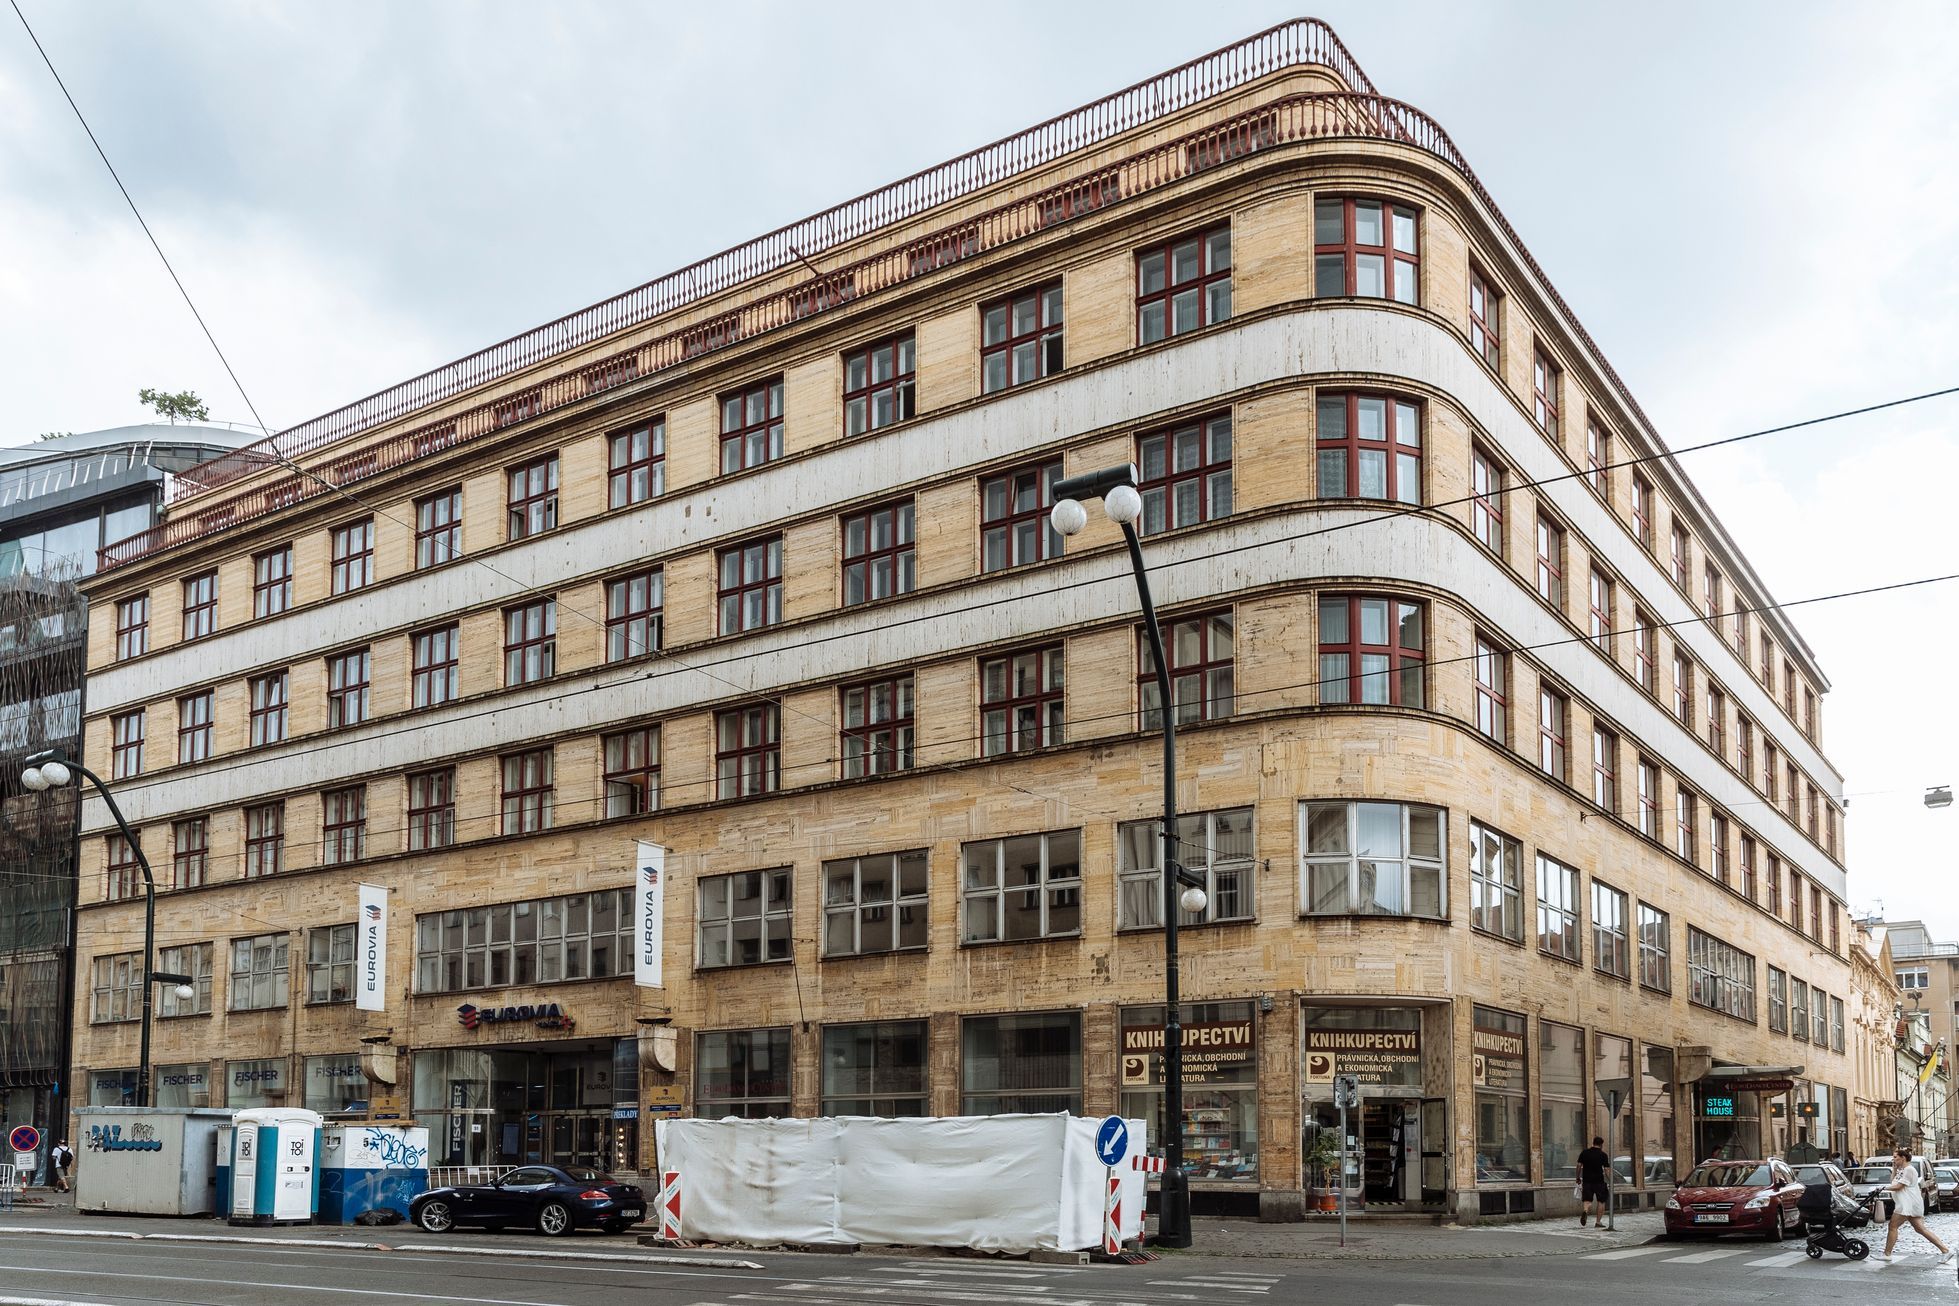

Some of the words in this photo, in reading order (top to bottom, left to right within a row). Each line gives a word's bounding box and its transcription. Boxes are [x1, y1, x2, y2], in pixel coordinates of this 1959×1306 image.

[645, 890, 653, 965] EUROVIA
[367, 925, 377, 992] EUROVIA
[480, 1003, 562, 1022] EUROVIA
[1126, 1022, 1250, 1049] KNIHUPECTVÍ
[1310, 1032, 1416, 1049] KNIHKUPECTVÍ
[1474, 1031, 1523, 1055] KNIHKUPECTVÍ
[235, 1069, 278, 1081] FISCHER
[315, 1065, 361, 1078] FISCHER
[1345, 1064, 1393, 1072] EKONOMICKÁ
[163, 1074, 203, 1086] FISCHER
[1707, 1099, 1733, 1107] STEAK
[1707, 1107, 1734, 1116] HOUSE
